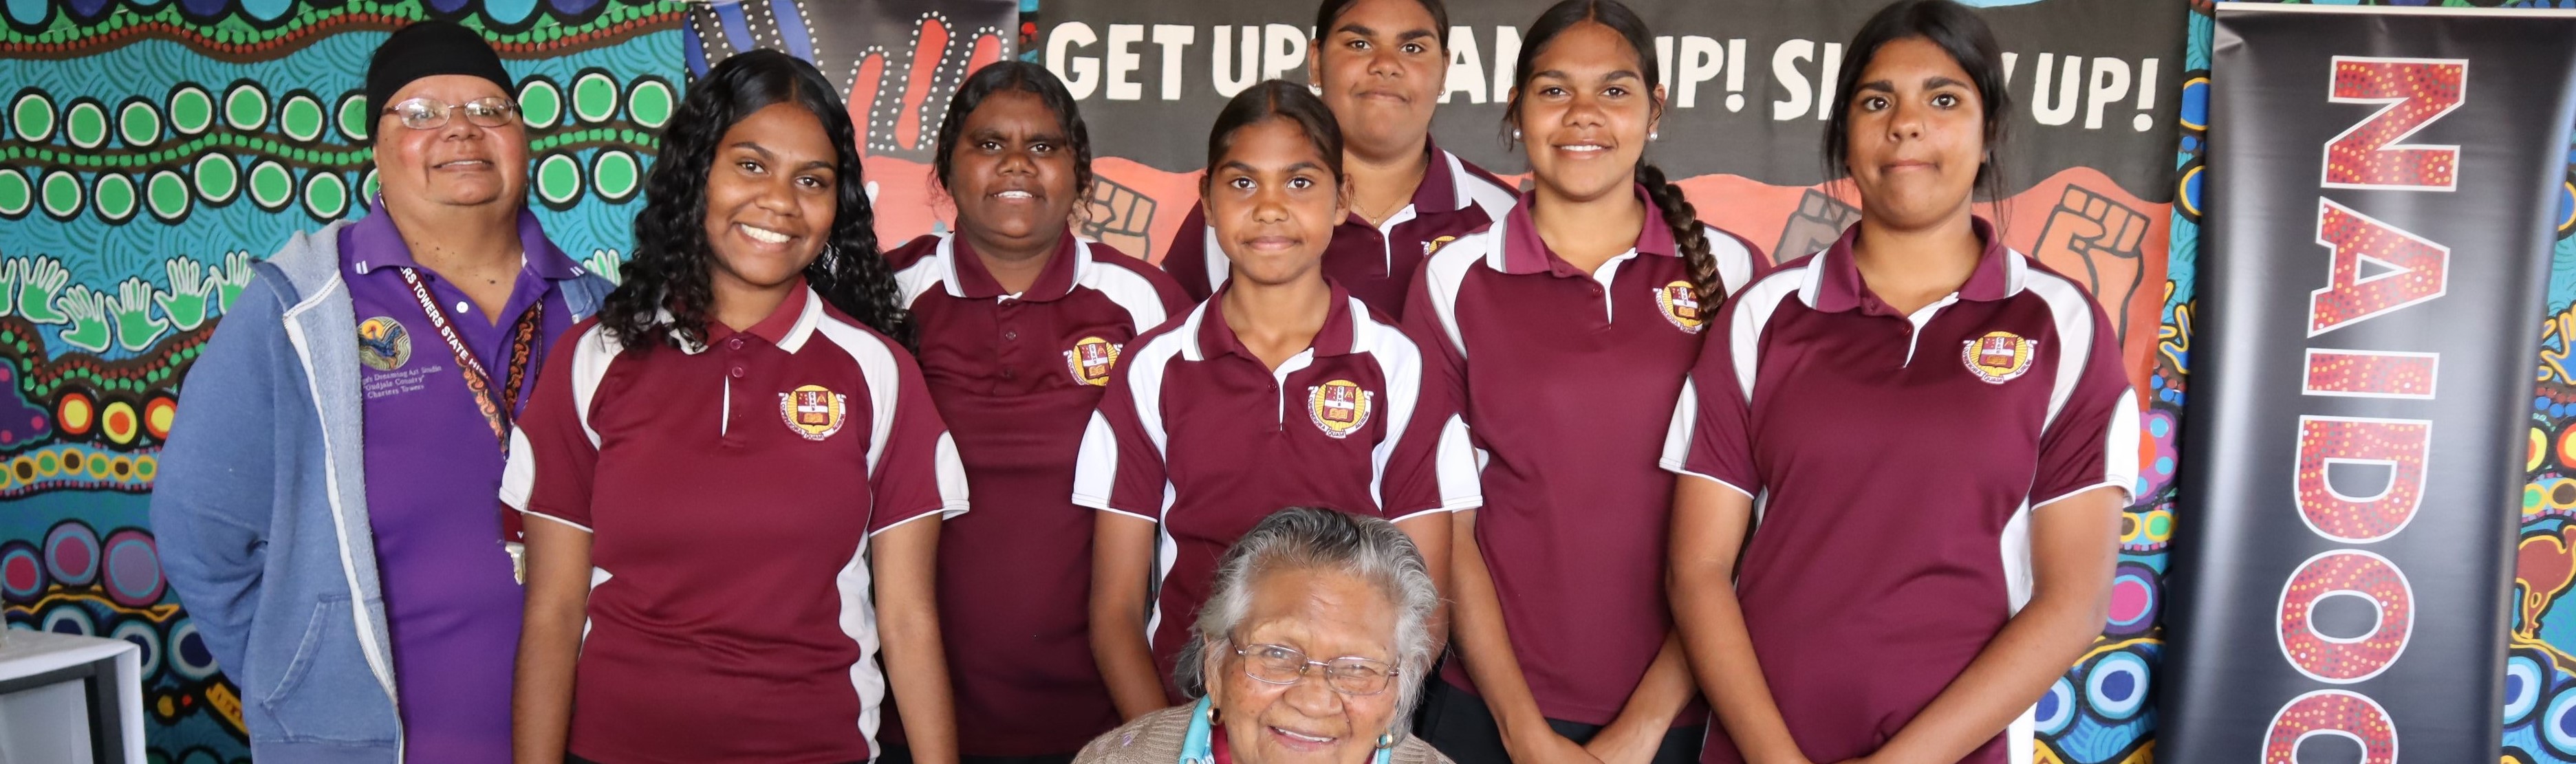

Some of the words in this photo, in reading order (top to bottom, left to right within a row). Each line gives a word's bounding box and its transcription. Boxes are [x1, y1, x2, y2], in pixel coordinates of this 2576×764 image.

[1046, 21, 1195, 100] GET
[1213, 23, 1322, 98] UP
[2032, 52, 2159, 132] UP!
[413, 281, 444, 328] TOWERS
[441, 325, 469, 360] STATE
[468, 358, 489, 379] HIG
[367, 389, 399, 399] Charters
[400, 384, 424, 393] Towers
